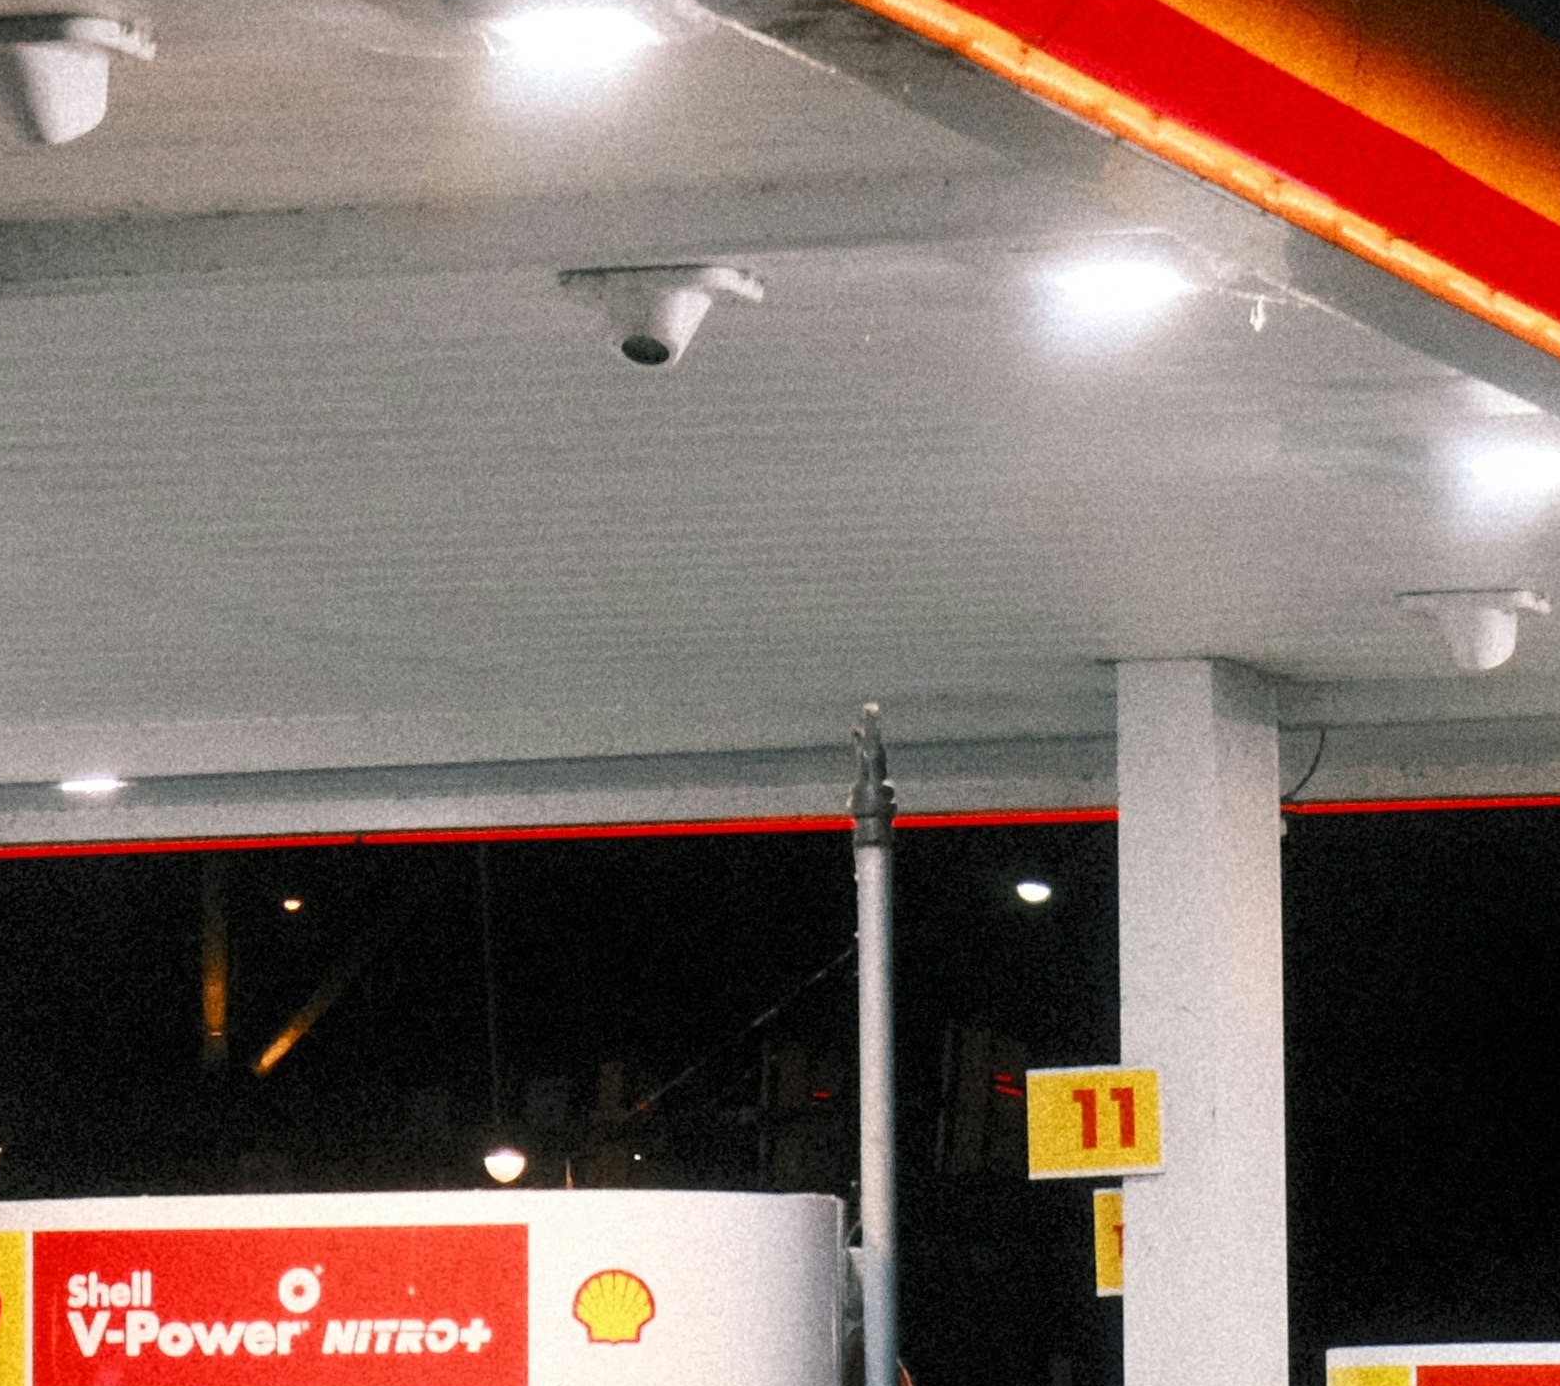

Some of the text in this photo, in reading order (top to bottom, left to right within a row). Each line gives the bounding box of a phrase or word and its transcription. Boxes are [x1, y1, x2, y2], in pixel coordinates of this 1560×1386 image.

[1072, 1088, 1136, 1149] 11
[67, 1270, 152, 1309] Shell
[67, 1311, 492, 1357] V-Power NITRO+
